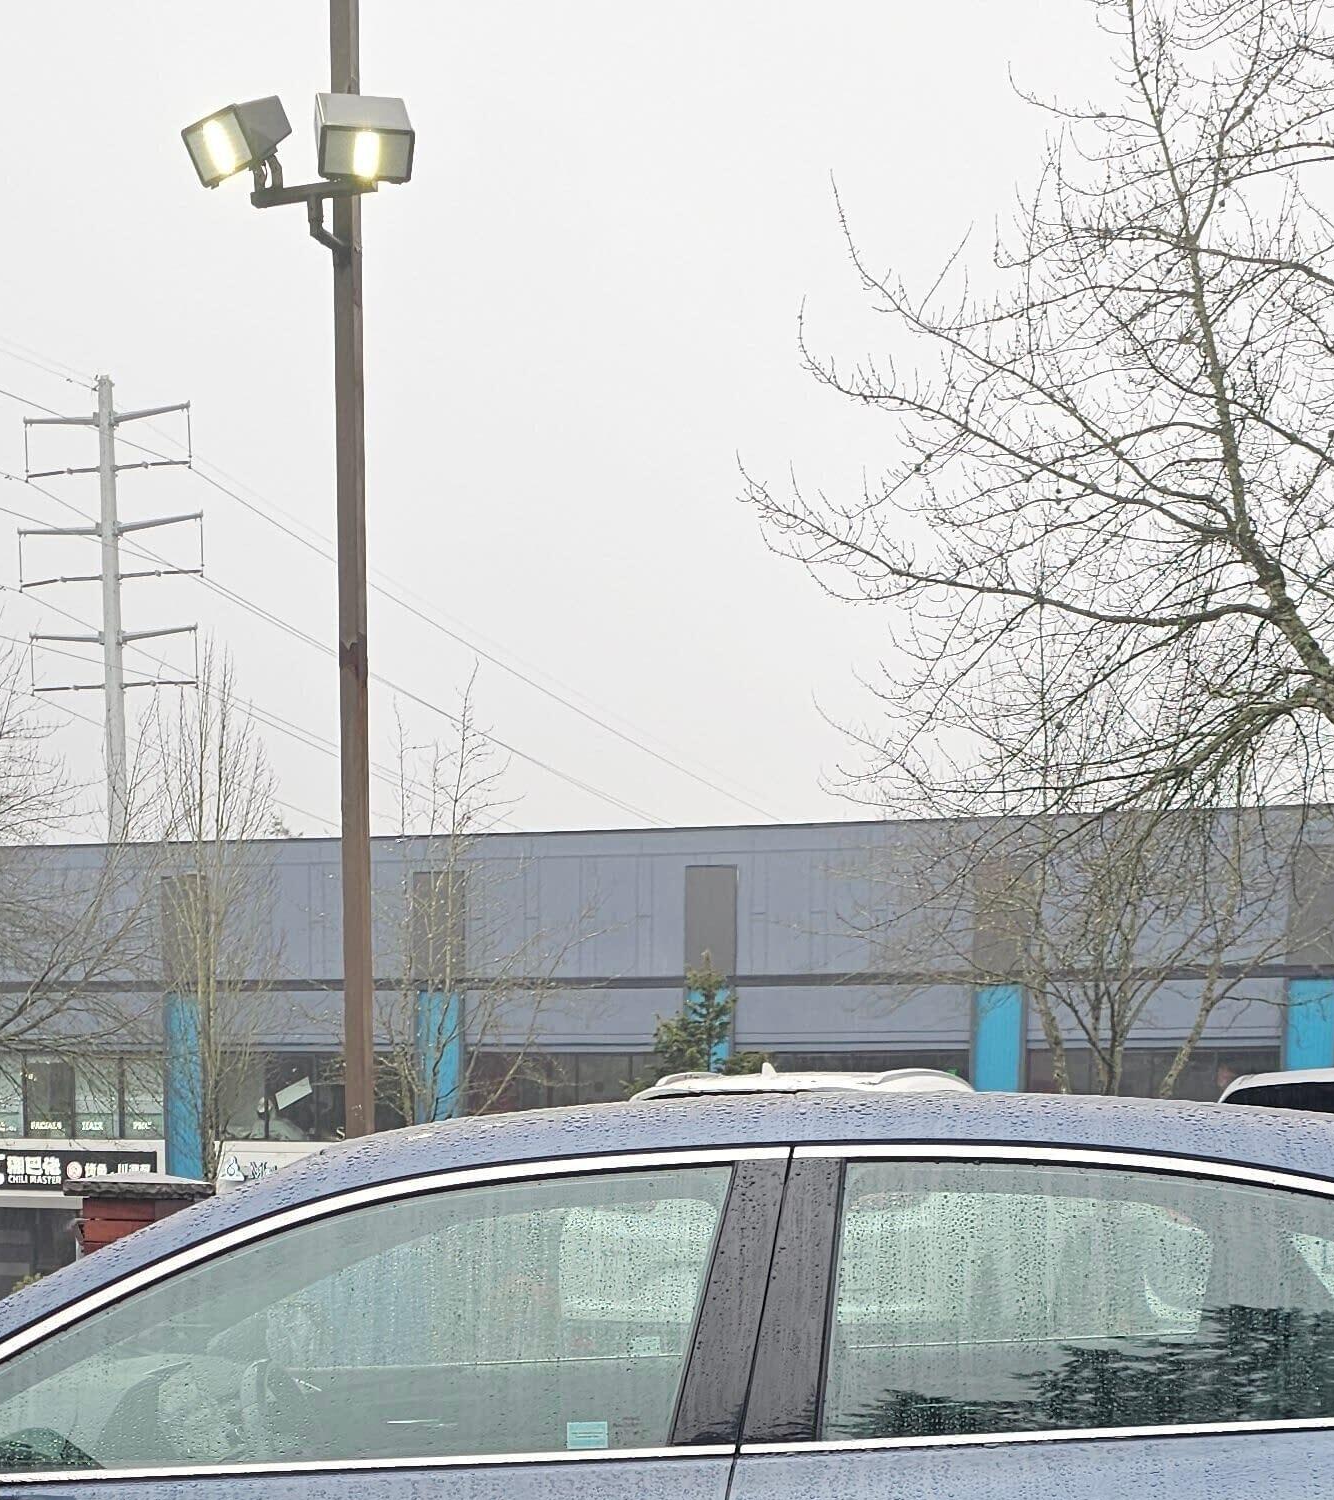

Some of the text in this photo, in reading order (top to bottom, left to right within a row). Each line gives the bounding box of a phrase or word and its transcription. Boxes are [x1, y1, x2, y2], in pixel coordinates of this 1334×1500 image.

[81, 1121, 104, 1131] HAIR
[8, 1175, 61, 1184] CHILI MASTER
